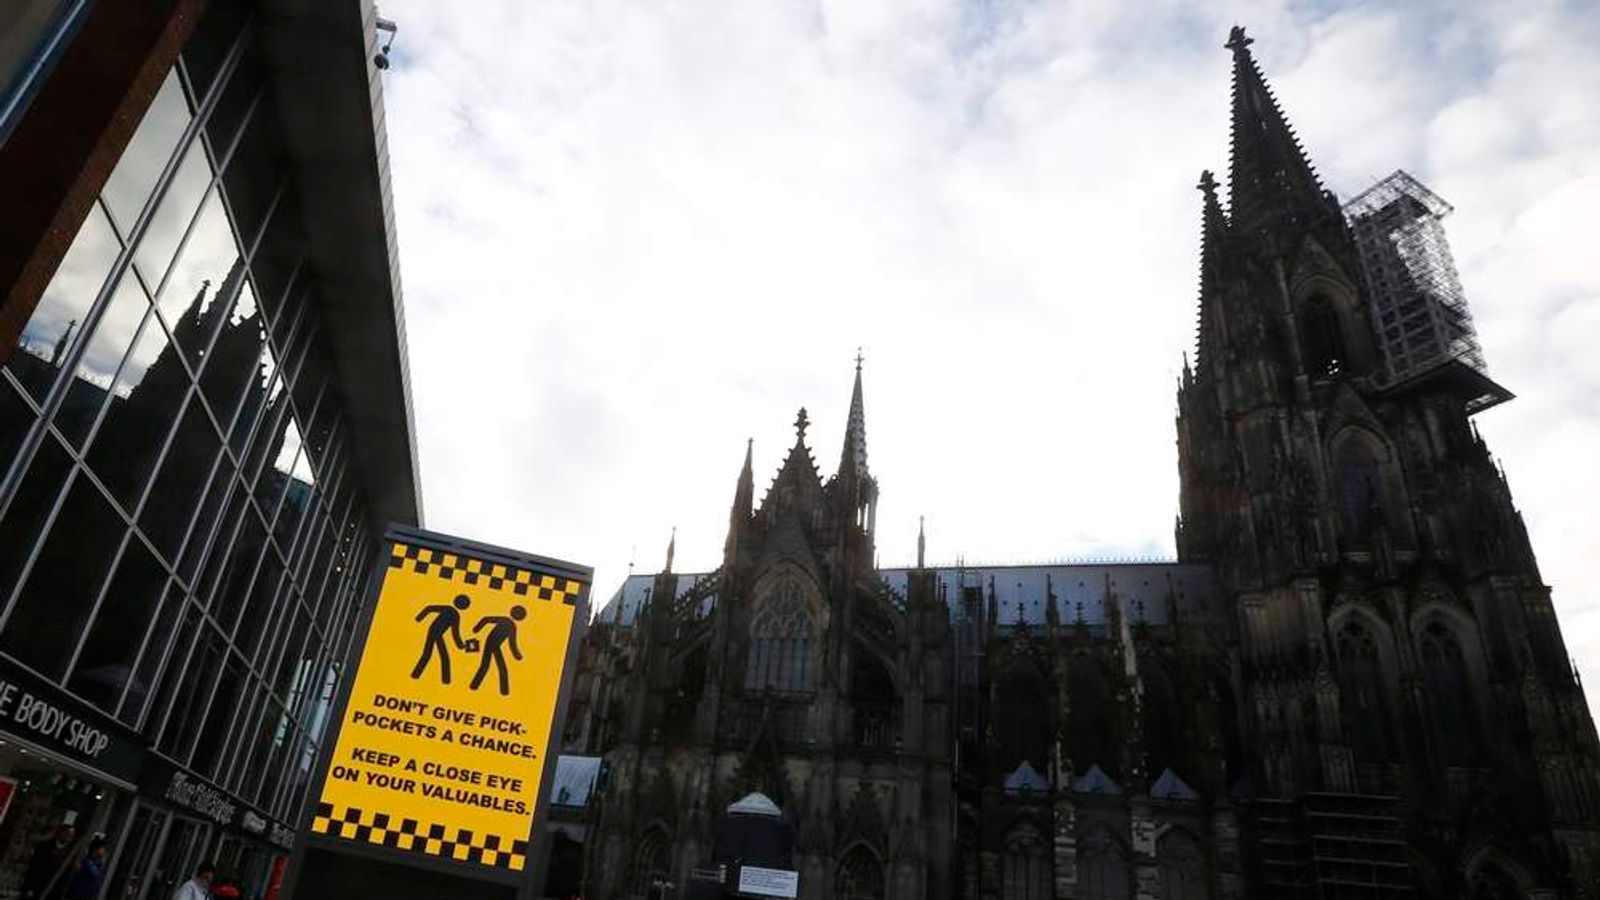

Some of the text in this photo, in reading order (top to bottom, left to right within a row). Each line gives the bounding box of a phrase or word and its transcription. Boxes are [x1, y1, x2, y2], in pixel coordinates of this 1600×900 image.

[14, 693, 71, 739] BODY
[64, 719, 109, 757] SHOP
[353, 711, 537, 760] POCKETS A CHANCE.
[374, 694, 527, 735] DON'T GIVE PICK-
[332, 766, 531, 816] ON YOUR VALUABLES.
[352, 747, 522, 793] KEEP A CLOSE EYE
